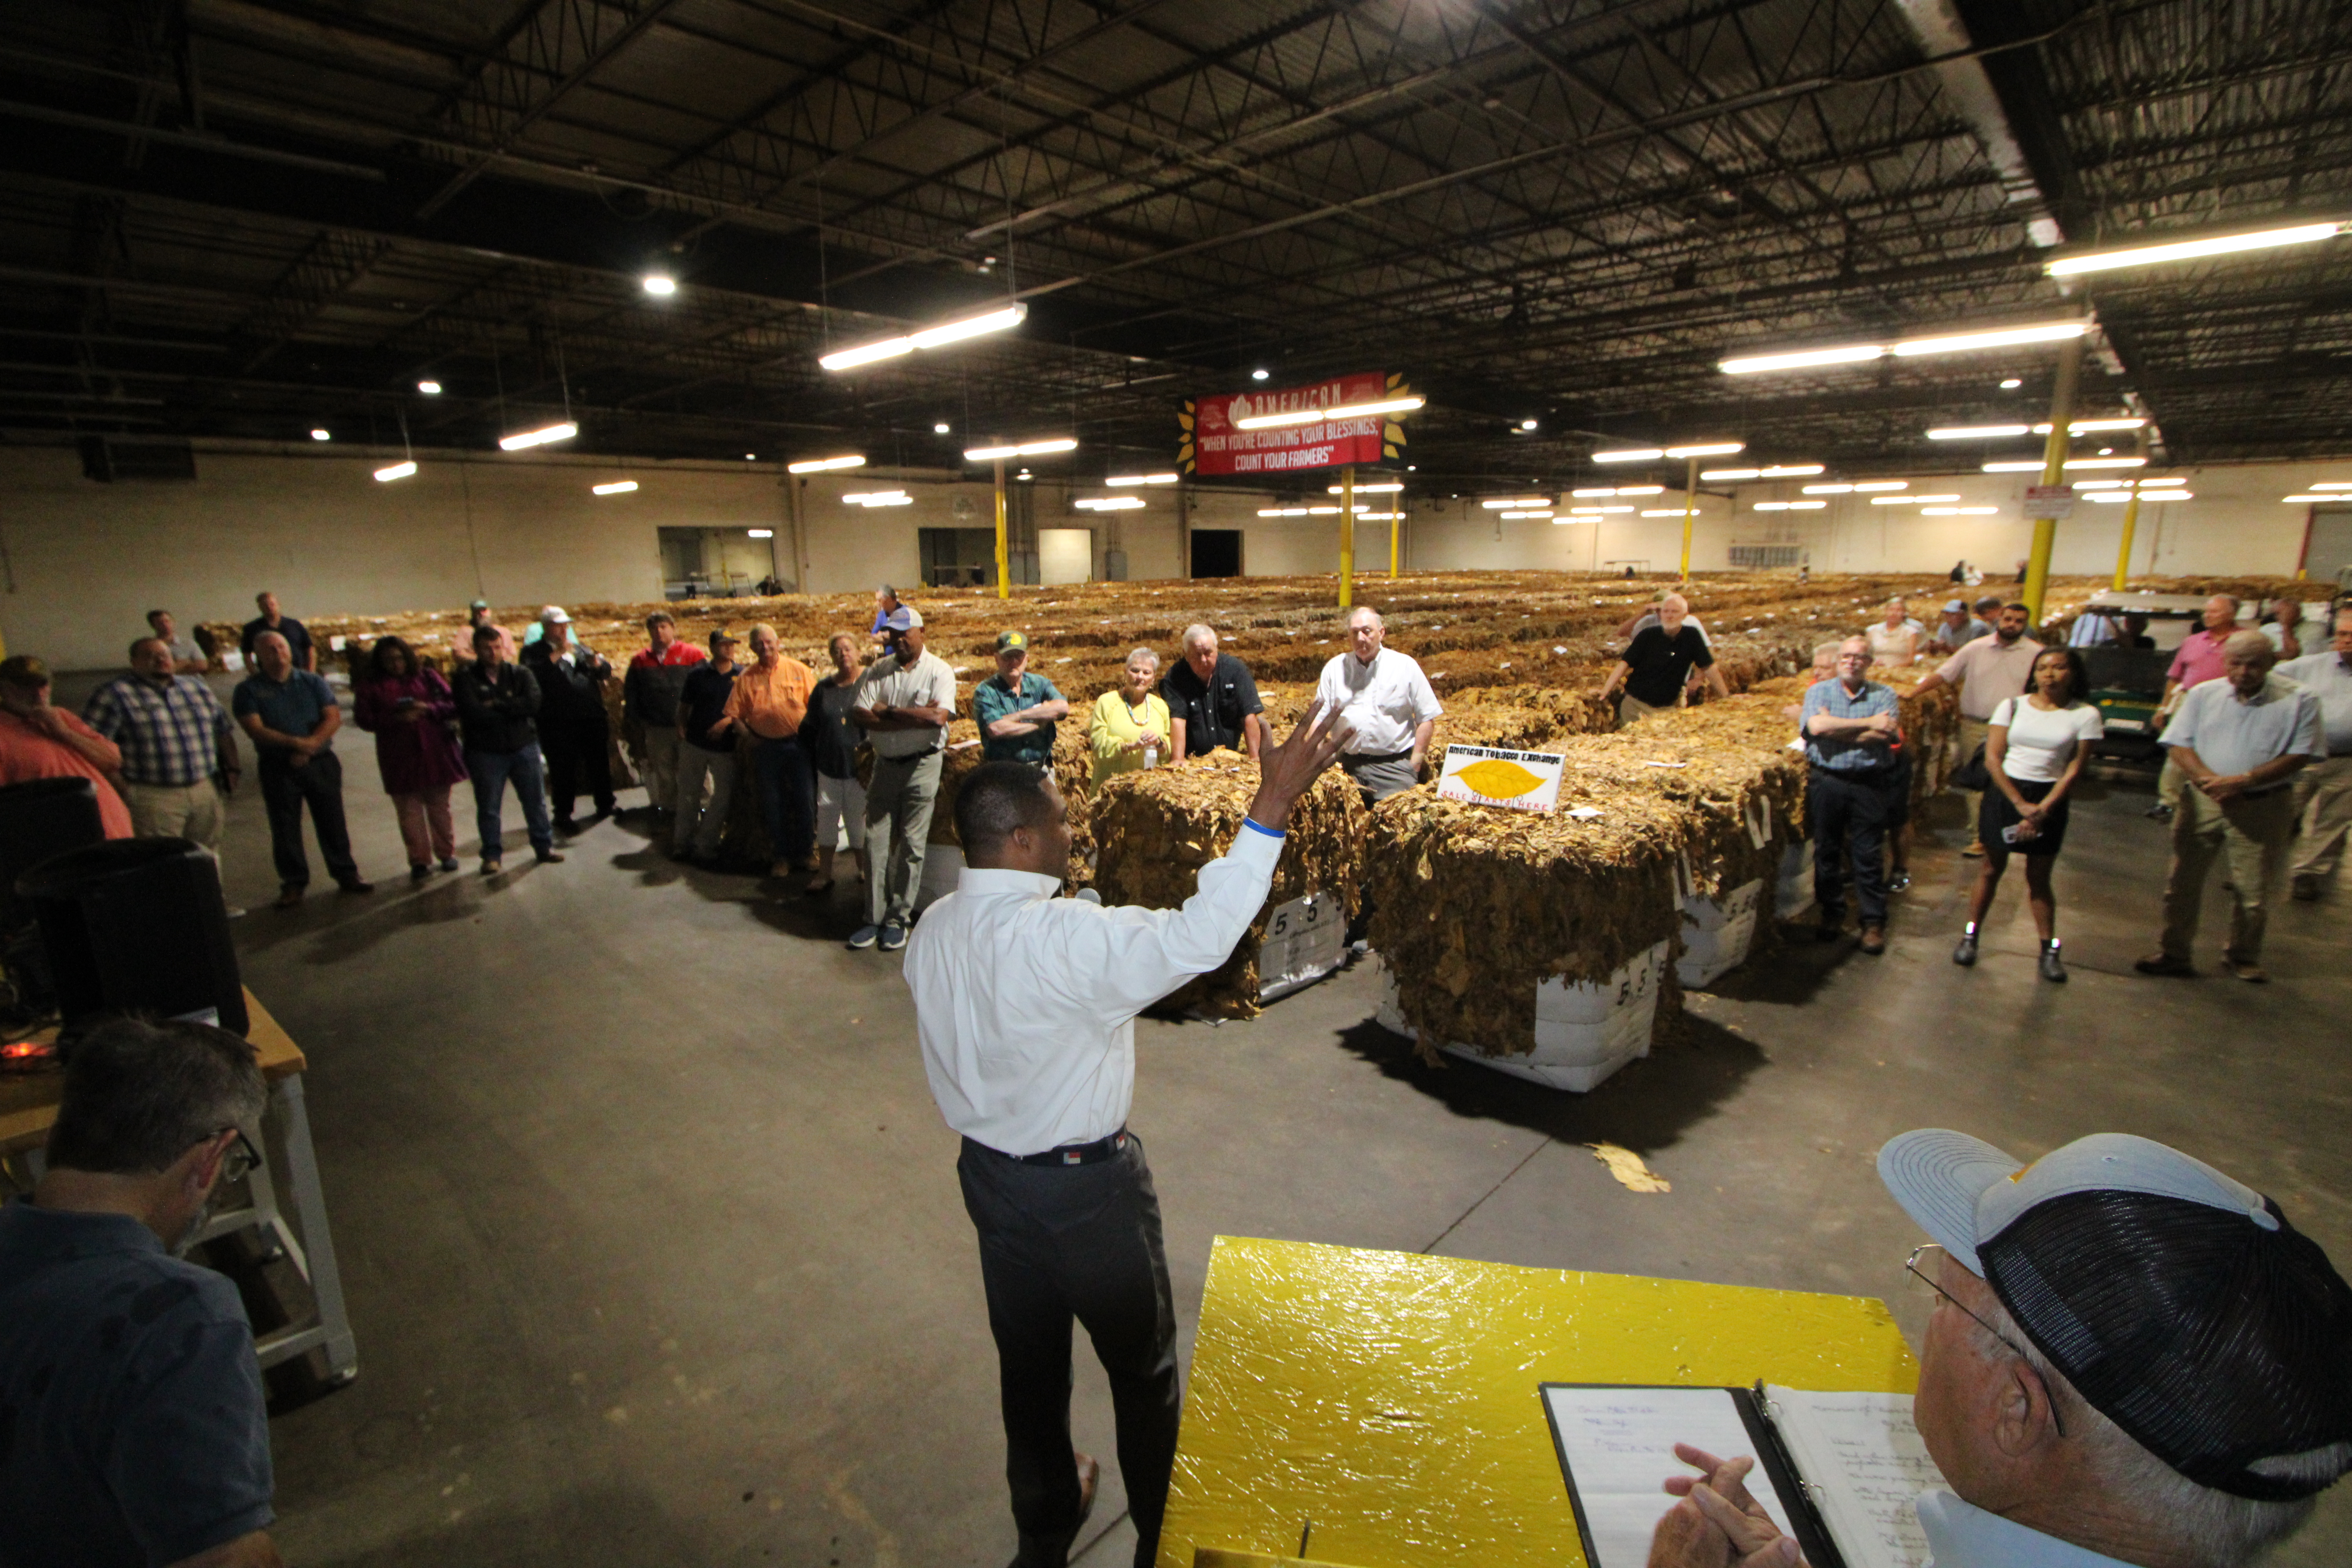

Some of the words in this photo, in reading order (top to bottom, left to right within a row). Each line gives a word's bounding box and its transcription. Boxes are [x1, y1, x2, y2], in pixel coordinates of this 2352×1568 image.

[1255, 383, 1341, 417] AMERICAN
[1257, 429, 1299, 448] COUNTING
[1301, 425, 1324, 444] YOUR
[1326, 417, 1378, 440] BLESSINGS,
[1236, 454, 1262, 470] COUNT
[1264, 452, 1287, 469] YOUR
[1448, 746, 1484, 757] American
[1486, 749, 1519, 760] Tobacco
[1441, 791, 1466, 800] SALE
[1472, 795, 1511, 806] STARTS
[1519, 800, 1548, 810] HERE
[1275, 913, 1288, 935] 5
[1307, 899, 1318, 922] 5
